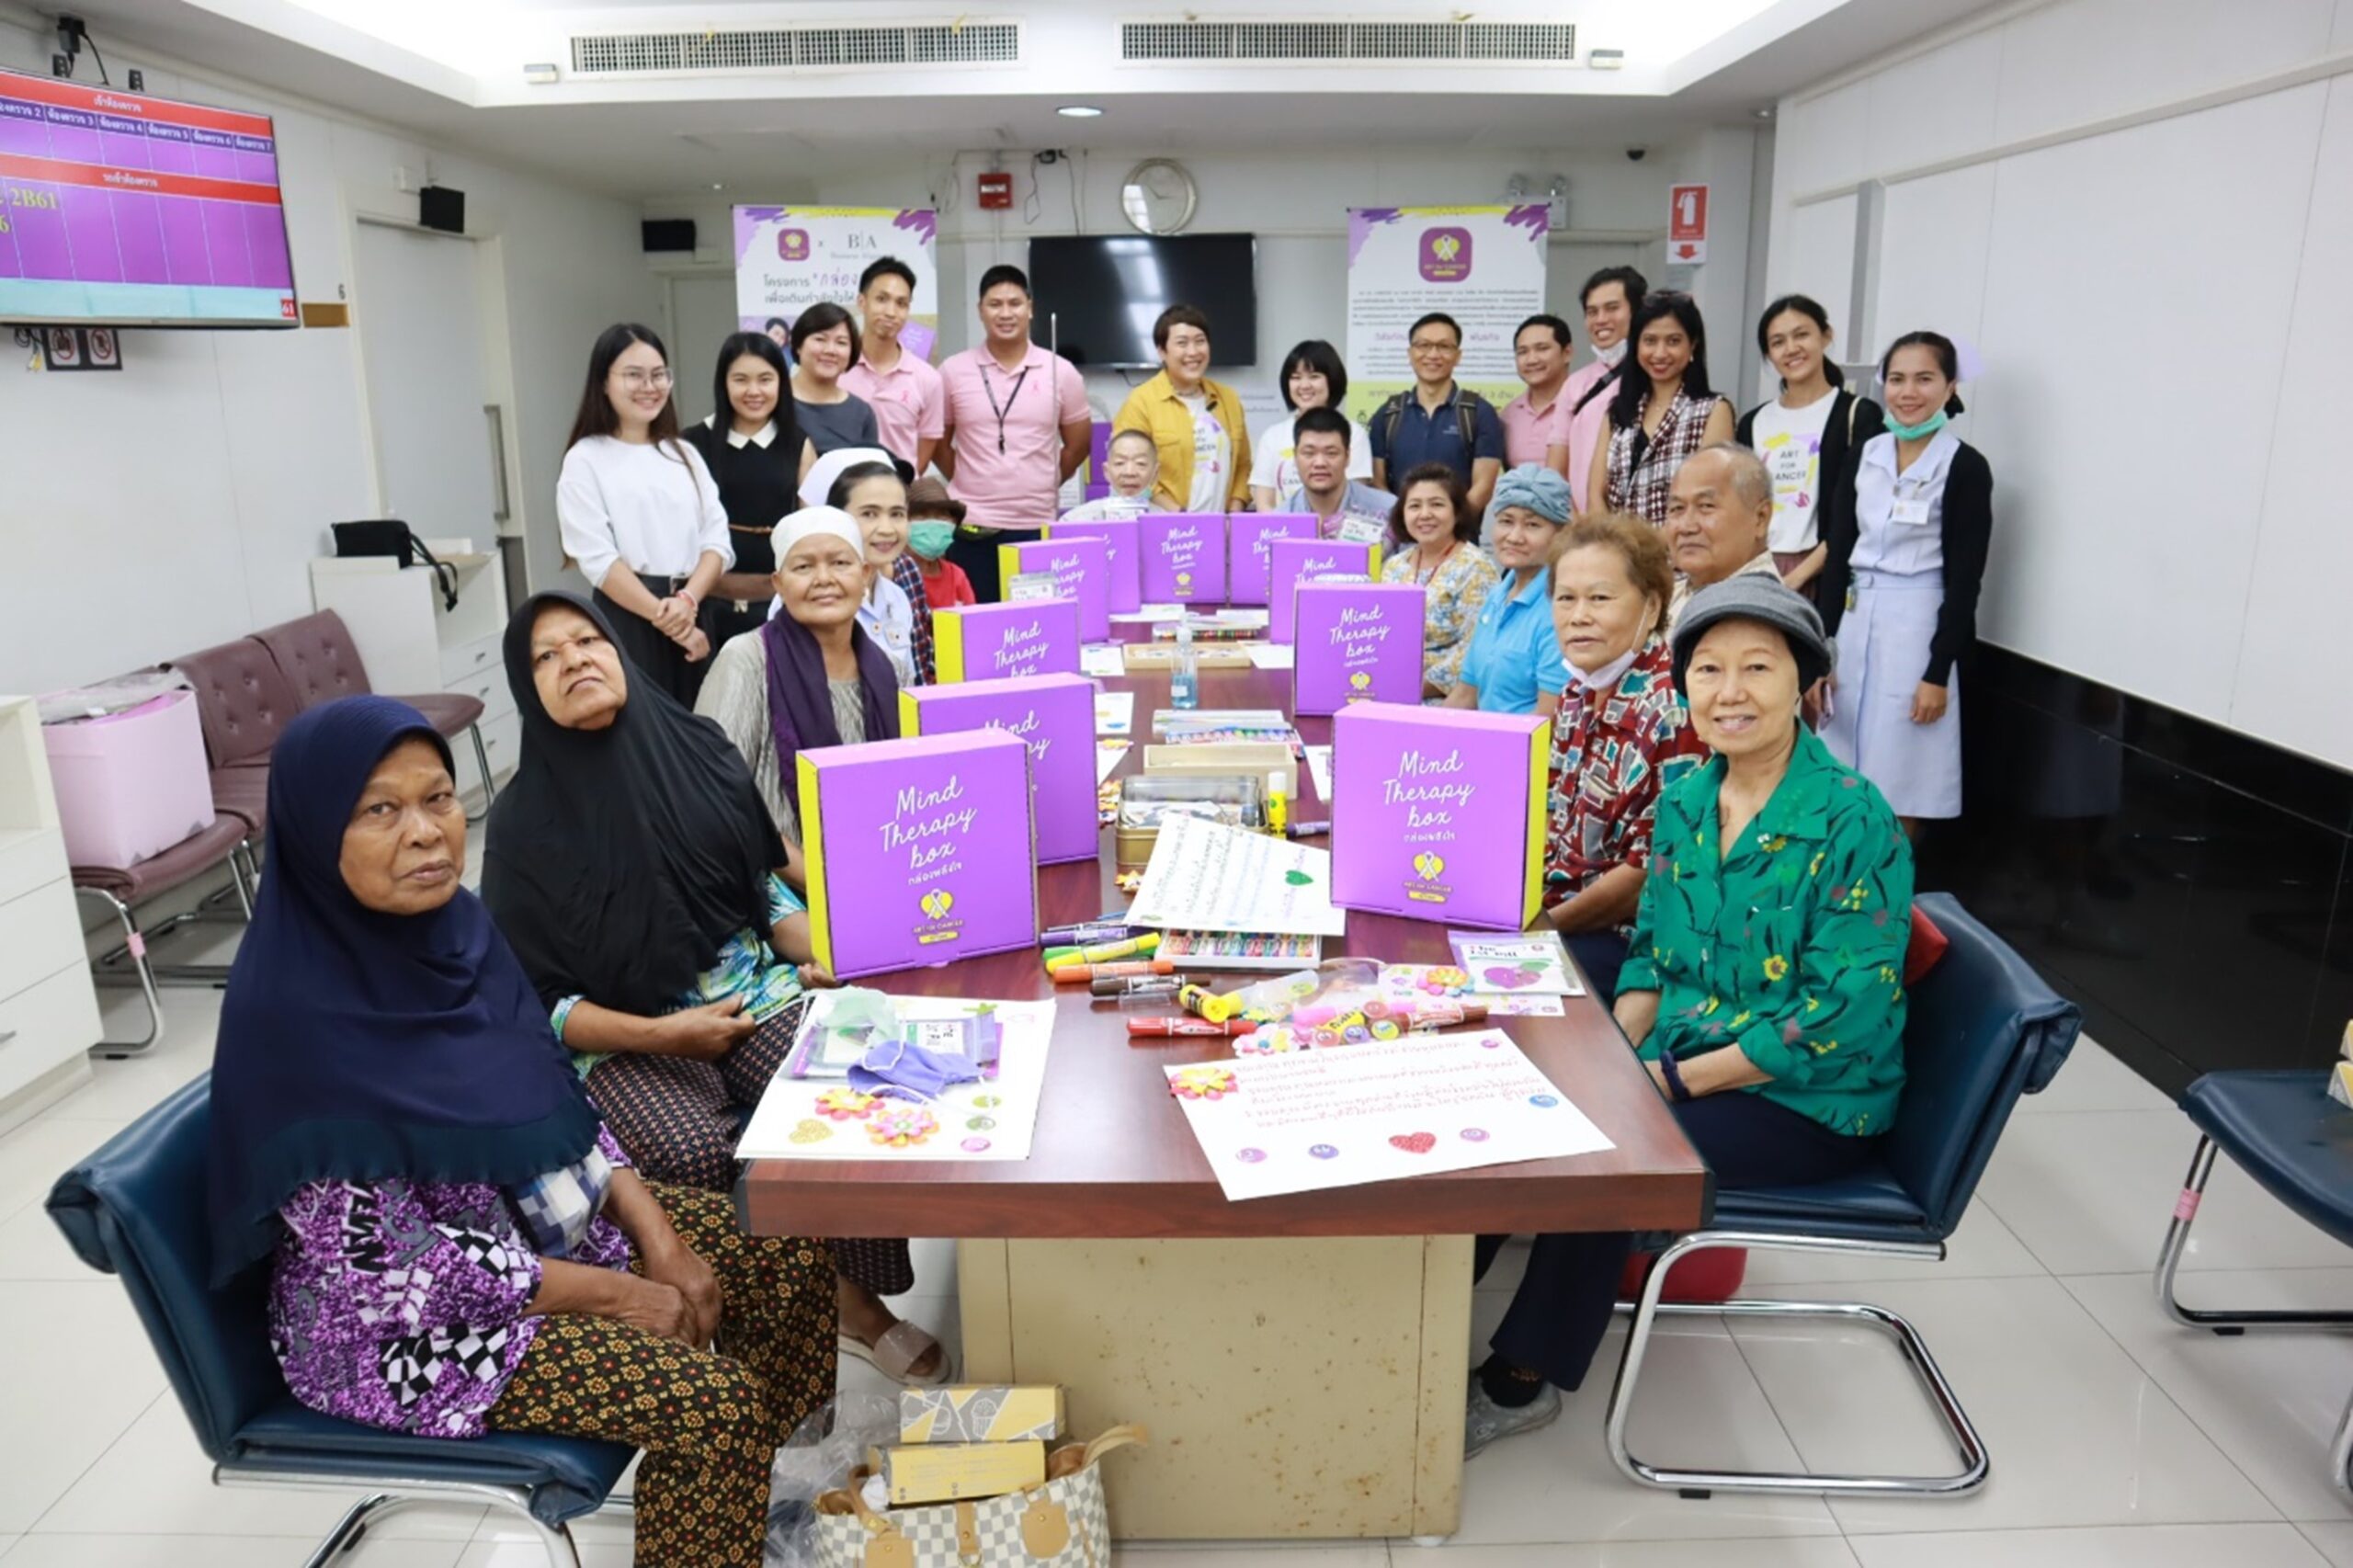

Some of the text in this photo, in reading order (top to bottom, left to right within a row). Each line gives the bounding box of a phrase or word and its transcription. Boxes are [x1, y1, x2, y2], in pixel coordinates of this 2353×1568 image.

[10, 187, 57, 209] 2B61
[1775, 470, 1806, 481] ANCER
[1259, 526, 1290, 542] Mind
[1302, 556, 1336, 573] Mind
[1340, 603, 1384, 627] Mind
[1003, 620, 1042, 649] Mind
[1330, 625, 1391, 645] Therapy
[994, 642, 1050, 671] Therapy
[1346, 642, 1376, 658] box
[1398, 749, 1464, 778] Mind
[895, 775, 963, 820] Mind
[1382, 778, 1476, 807] Therapy
[1407, 805, 1452, 828] box
[880, 808, 978, 852] Therapy
[910, 842, 957, 869] box
